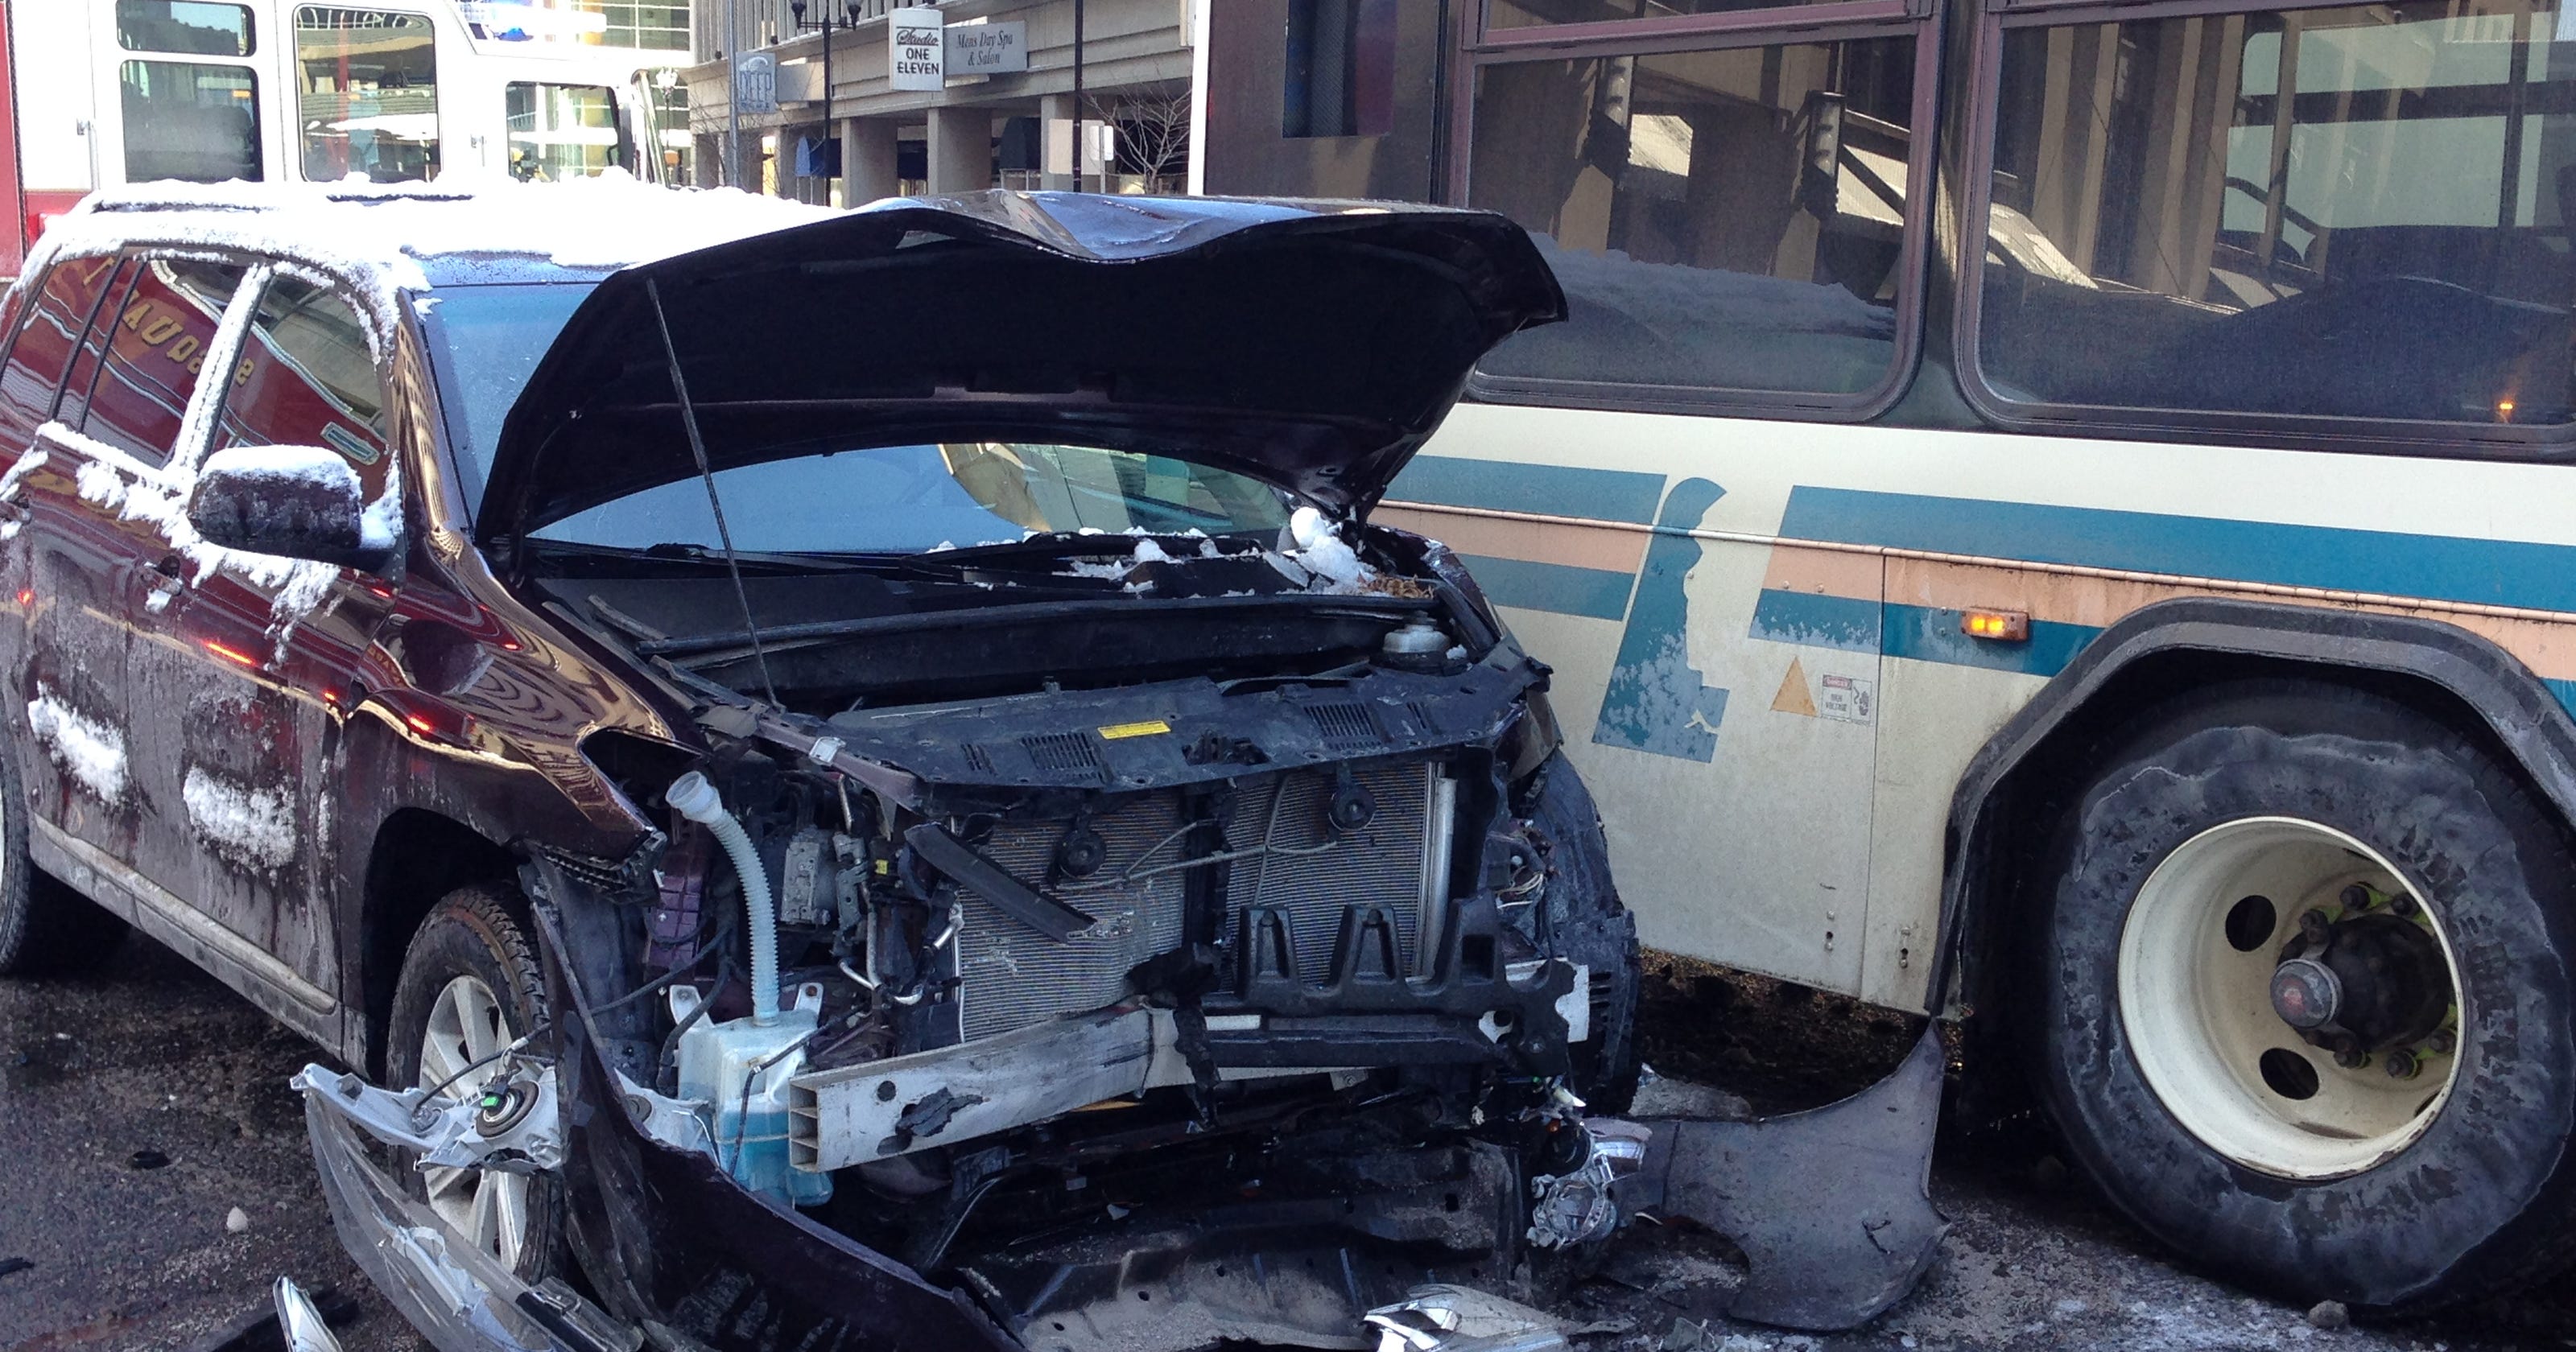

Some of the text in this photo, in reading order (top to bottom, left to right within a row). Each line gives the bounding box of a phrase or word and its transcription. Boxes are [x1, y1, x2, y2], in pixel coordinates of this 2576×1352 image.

[896, 27, 939, 46] Studio
[979, 32, 996, 47] Day
[997, 30, 1013, 49] Spa
[906, 47, 930, 60] ONE
[968, 47, 1000, 66] & Salon
[897, 61, 939, 75] ELEVEN
